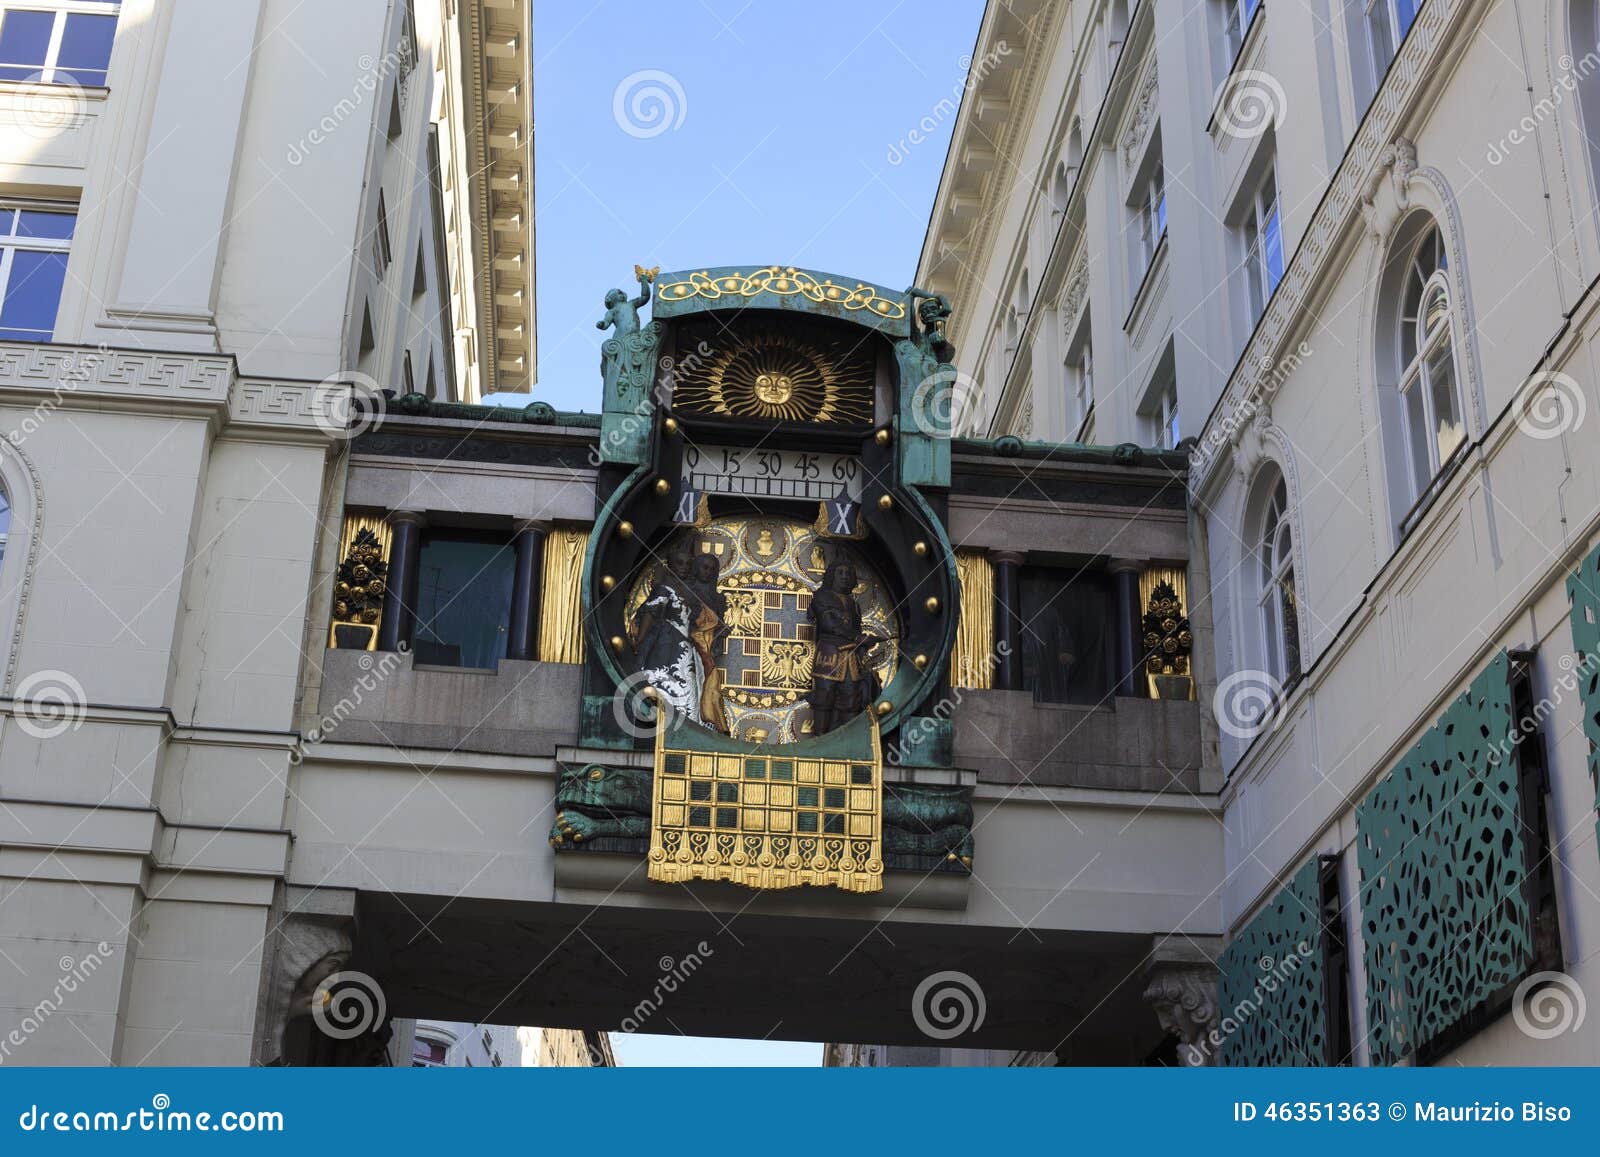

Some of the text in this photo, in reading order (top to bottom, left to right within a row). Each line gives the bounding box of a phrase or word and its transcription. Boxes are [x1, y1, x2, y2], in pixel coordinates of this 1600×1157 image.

[686, 448, 857, 481] 0 15 30 45 60
[672, 492, 694, 522] XI
[834, 503, 852, 535] X
